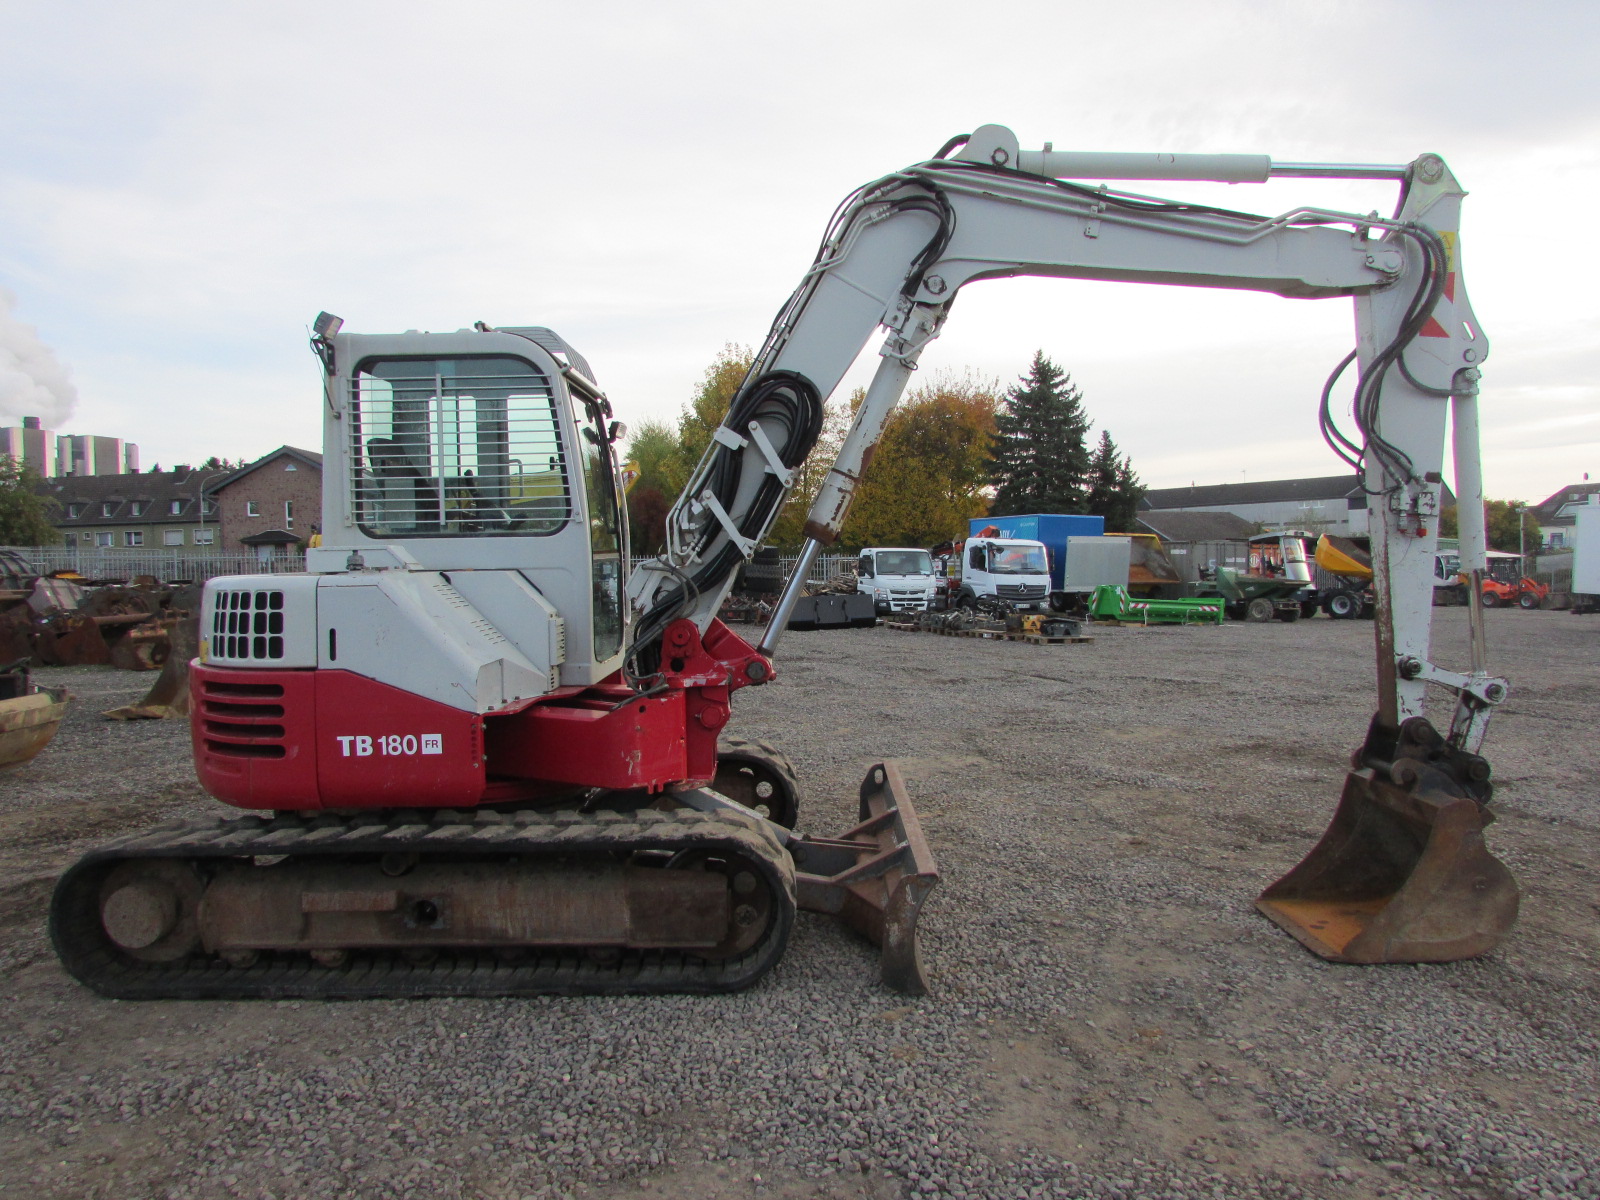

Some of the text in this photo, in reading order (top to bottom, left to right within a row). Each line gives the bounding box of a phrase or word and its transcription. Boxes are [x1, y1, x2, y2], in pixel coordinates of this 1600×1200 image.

[337, 734, 439, 756] TB 180 FR
